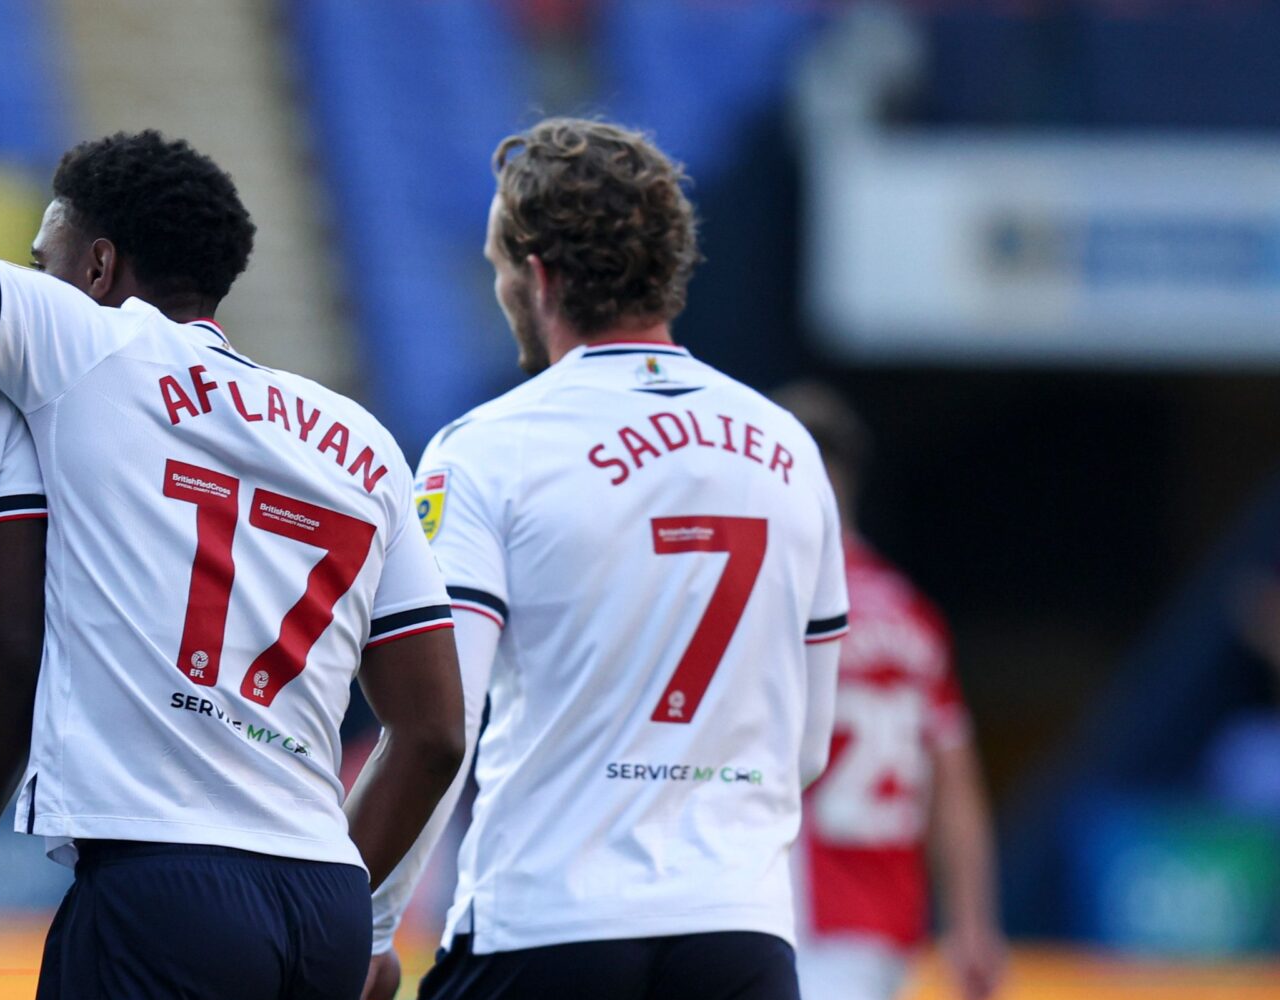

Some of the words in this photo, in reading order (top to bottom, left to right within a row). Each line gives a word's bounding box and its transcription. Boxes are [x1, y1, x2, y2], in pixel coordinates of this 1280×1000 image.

[589, 410, 794, 486] SADLIER
[259, 502, 320, 528] BritishRedCross
[163, 458, 377, 707] 17
[651, 515, 768, 724] 7
[190, 668, 205, 679] EFL
[253, 688, 265, 698] EFL
[247, 724, 280, 743] MY
[606, 762, 690, 781] SERVICE
[692, 766, 717, 782] MY
